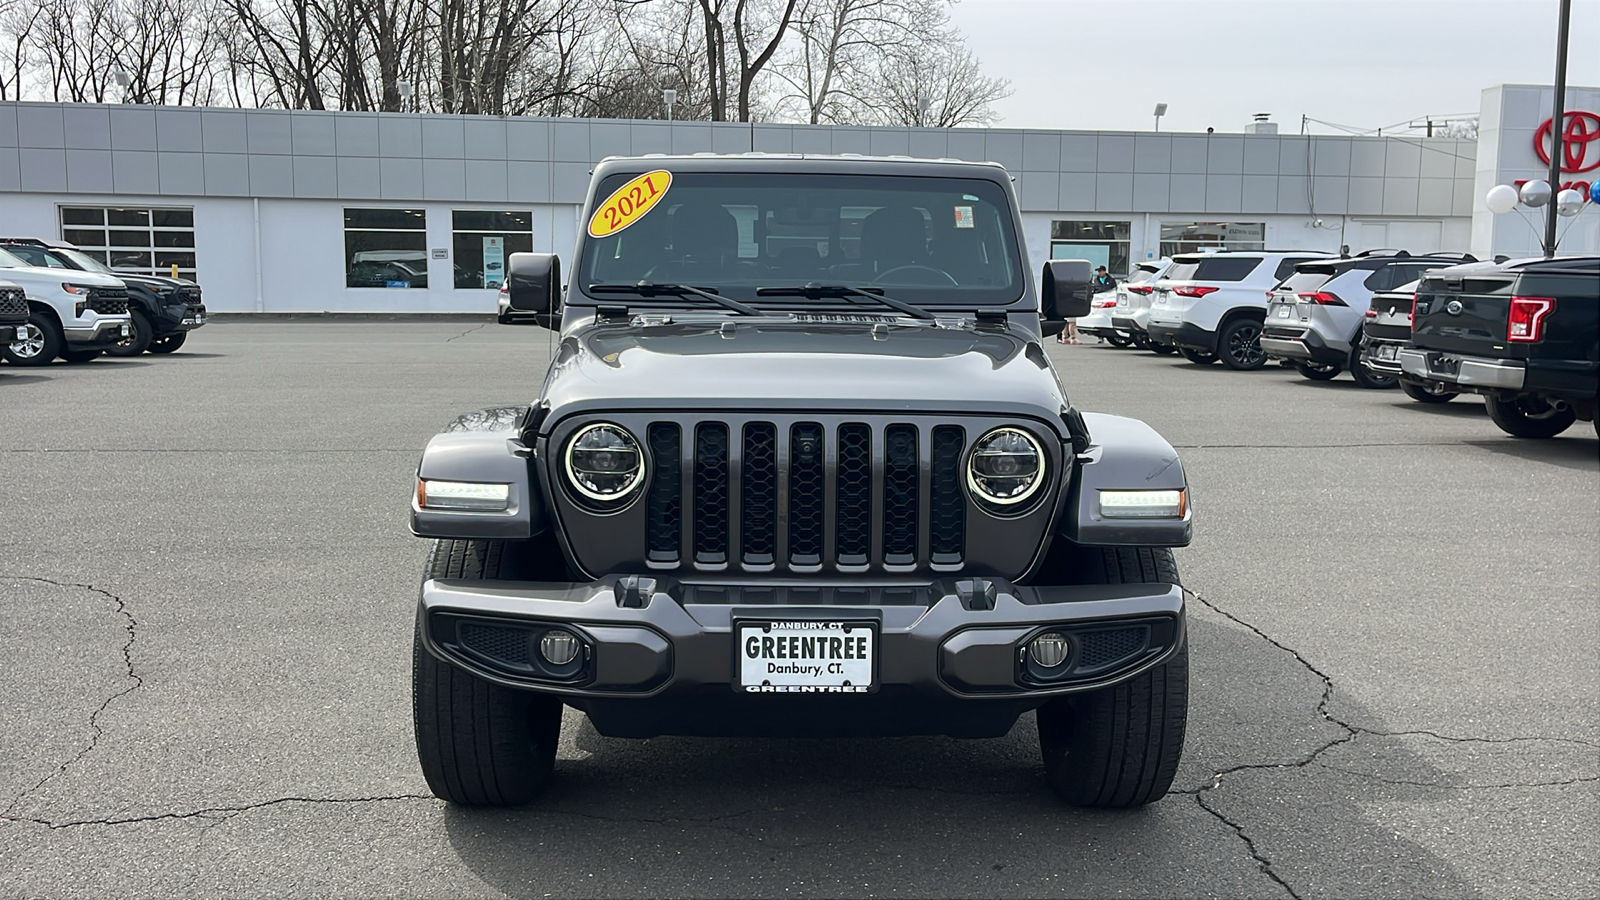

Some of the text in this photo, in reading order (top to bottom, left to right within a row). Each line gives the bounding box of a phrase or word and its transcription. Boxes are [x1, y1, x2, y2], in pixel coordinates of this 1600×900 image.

[604, 176, 660, 230] 2021
[771, 622, 844, 630] DANBURY, CT
[745, 636, 867, 659] GREENTREE
[767, 662, 844, 677] Danbury, CT.
